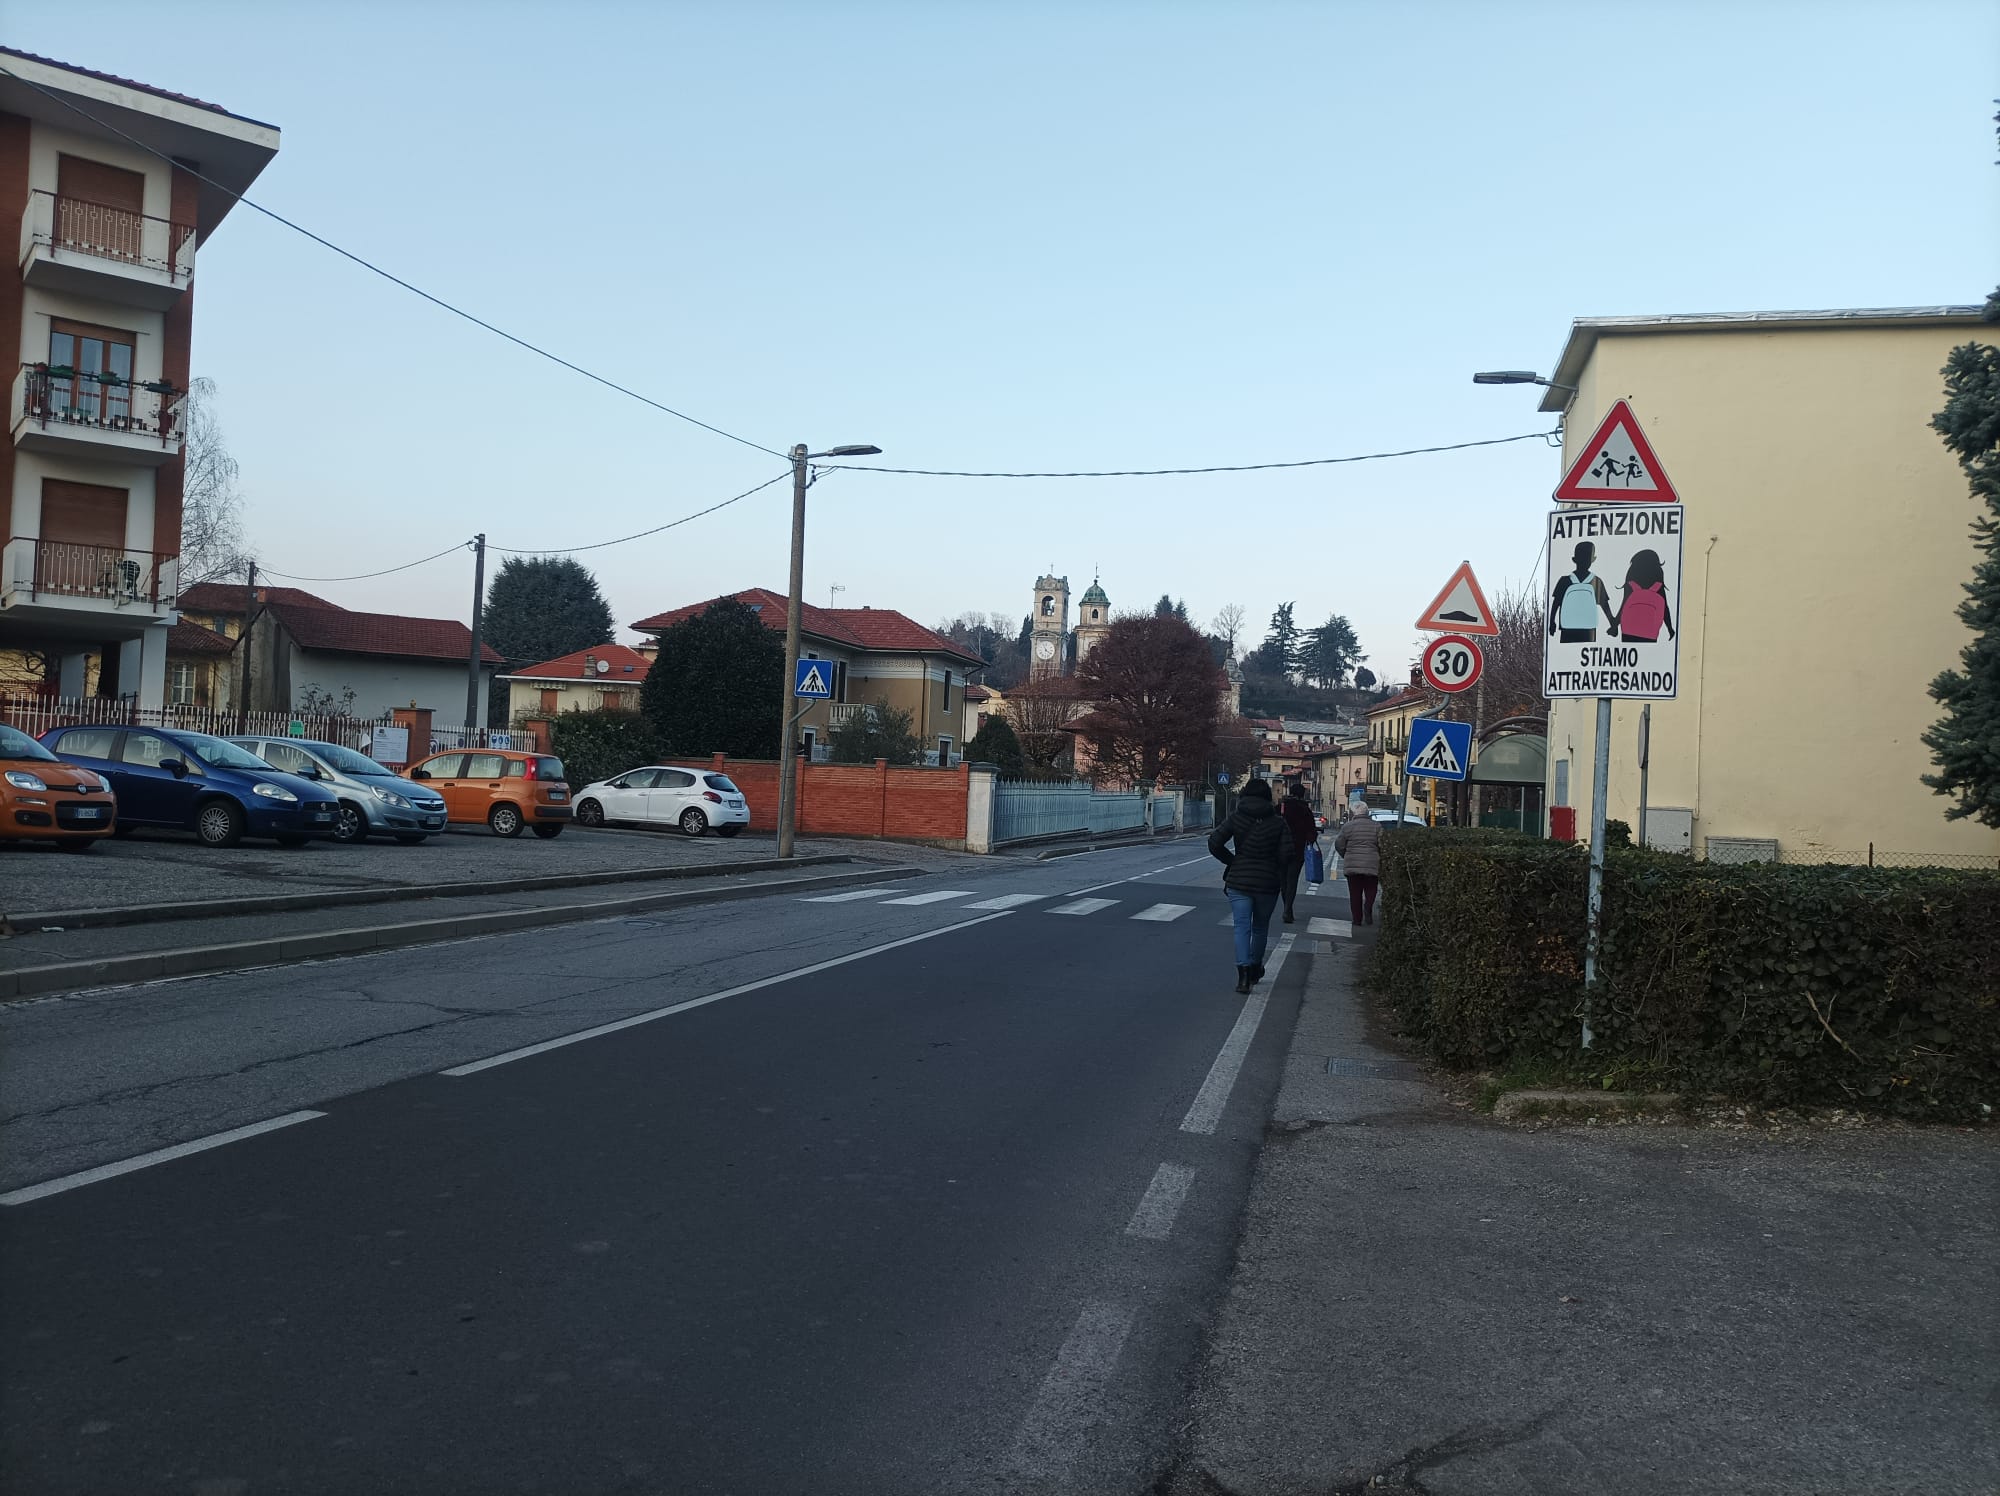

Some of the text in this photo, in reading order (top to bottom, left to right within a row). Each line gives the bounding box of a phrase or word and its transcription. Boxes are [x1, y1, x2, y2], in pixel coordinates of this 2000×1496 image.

[1552, 511, 1680, 539] ATTENZIONE
[1434, 649, 1469, 677] 30
[1580, 647, 1638, 667] STIAMO
[1548, 670, 1673, 691] ATTRAVERSANDO
